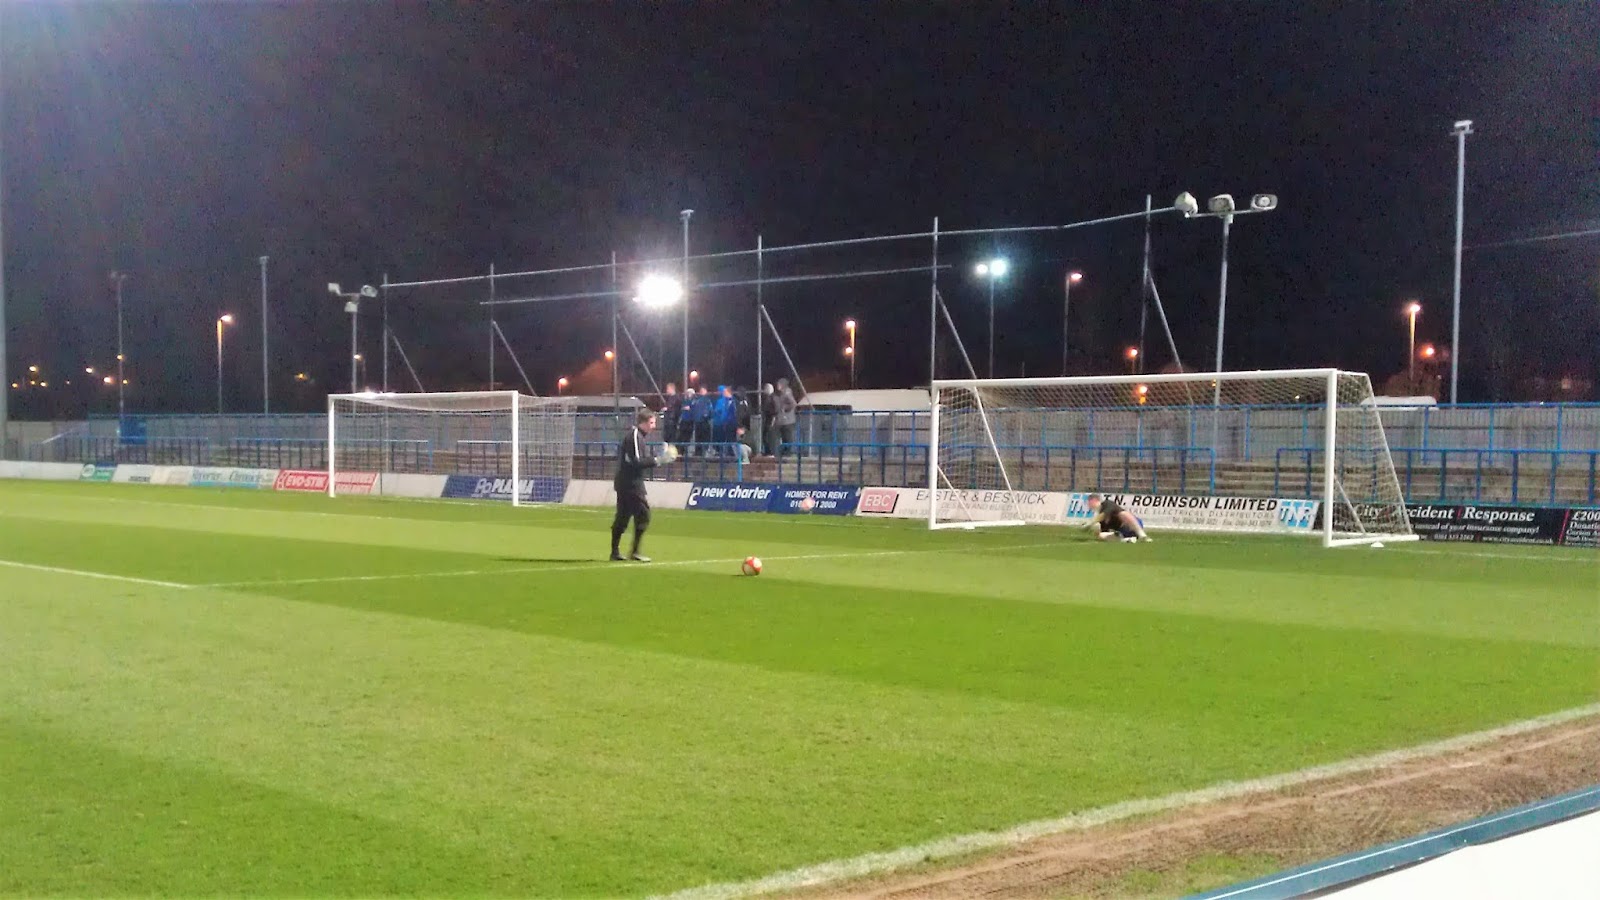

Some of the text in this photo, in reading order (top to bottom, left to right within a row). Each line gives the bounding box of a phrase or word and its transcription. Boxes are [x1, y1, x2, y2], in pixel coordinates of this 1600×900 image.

[491, 479, 534, 495] PLAMA
[702, 485, 771, 499] new charter
[785, 490, 848, 499] HOMES FOR RENT
[864, 494, 892, 508] EBC
[971, 491, 979, 502] &
[983, 491, 1047, 505] BESWICK
[1103, 494, 1278, 512] TN. ROBINSON LIMITED
[1462, 506, 1536, 525] Response
